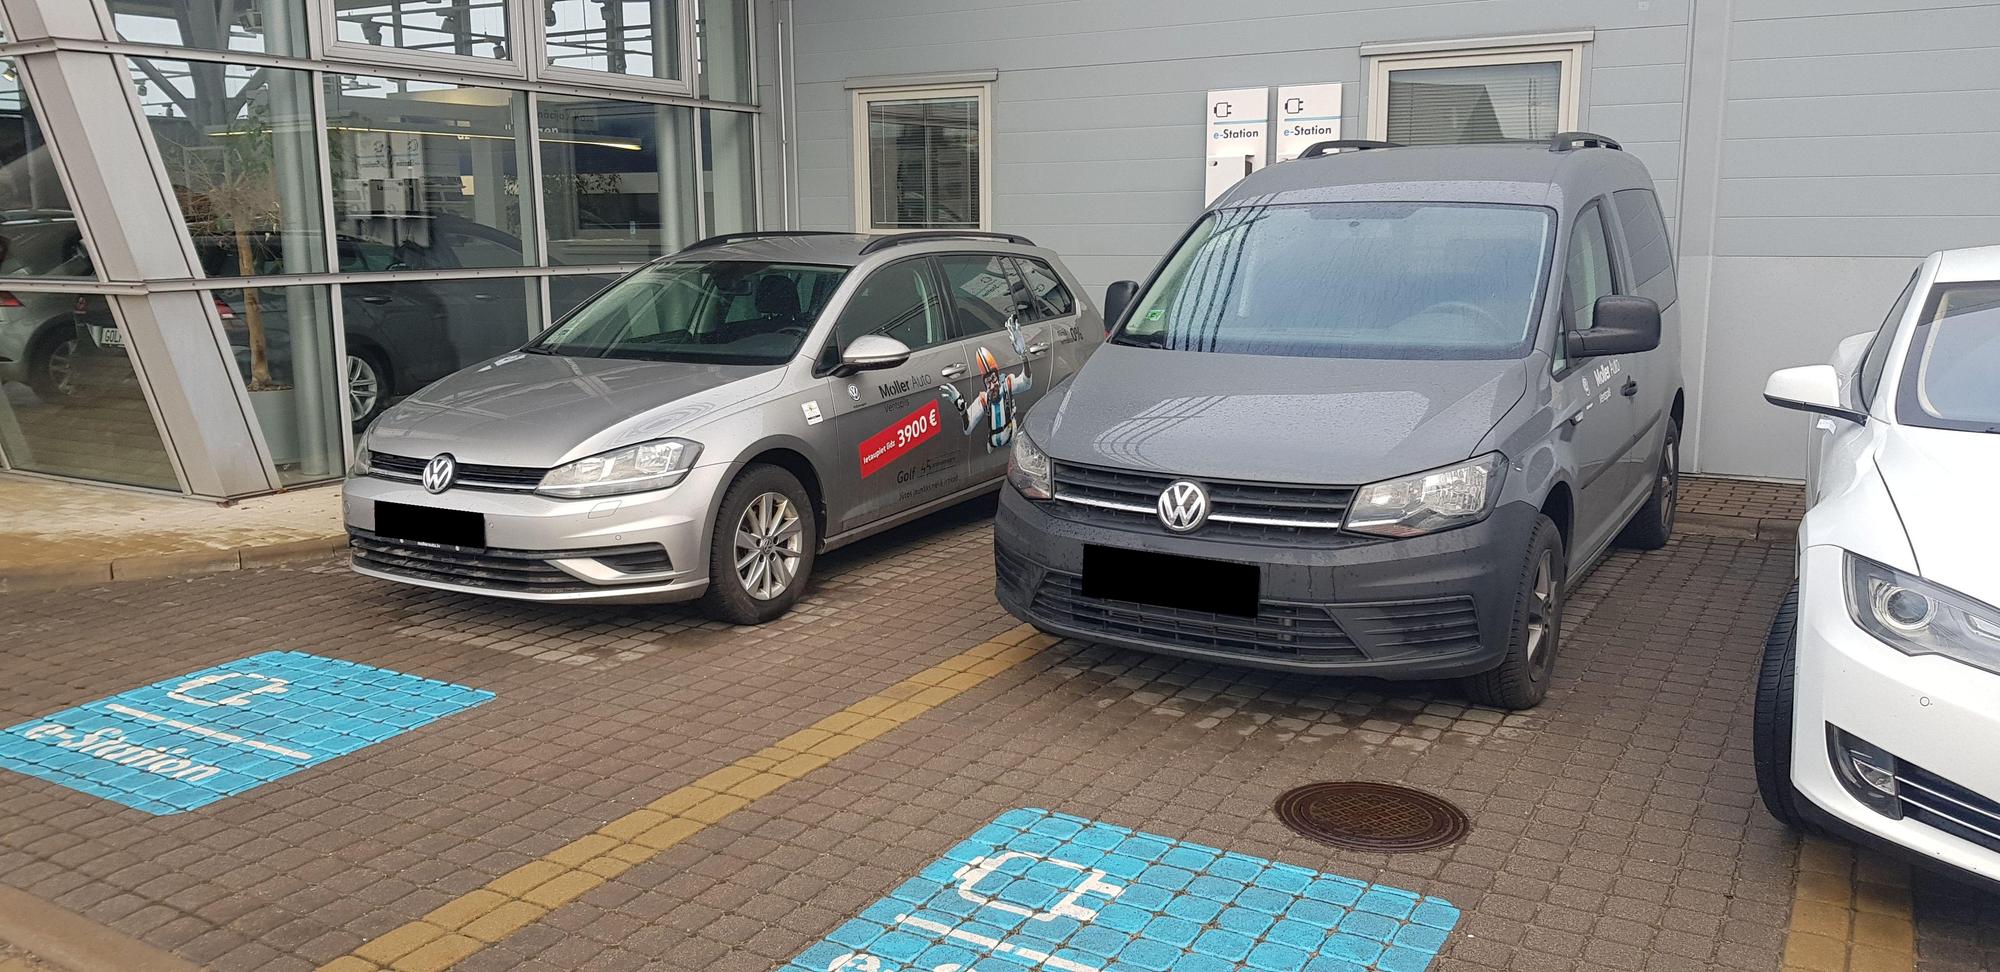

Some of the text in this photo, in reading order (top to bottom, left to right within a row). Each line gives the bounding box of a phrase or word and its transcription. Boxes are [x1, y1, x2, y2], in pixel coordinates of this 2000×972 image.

[1213, 128, 1259, 140] e-Station
[1283, 125, 1332, 136] e-Station
[911, 374, 932, 389] Auto
[896, 415, 927, 448] 3900
[929, 408, 938, 427] €
[896, 466, 916, 484] Golf
[24, 724, 221, 782] e-Station
